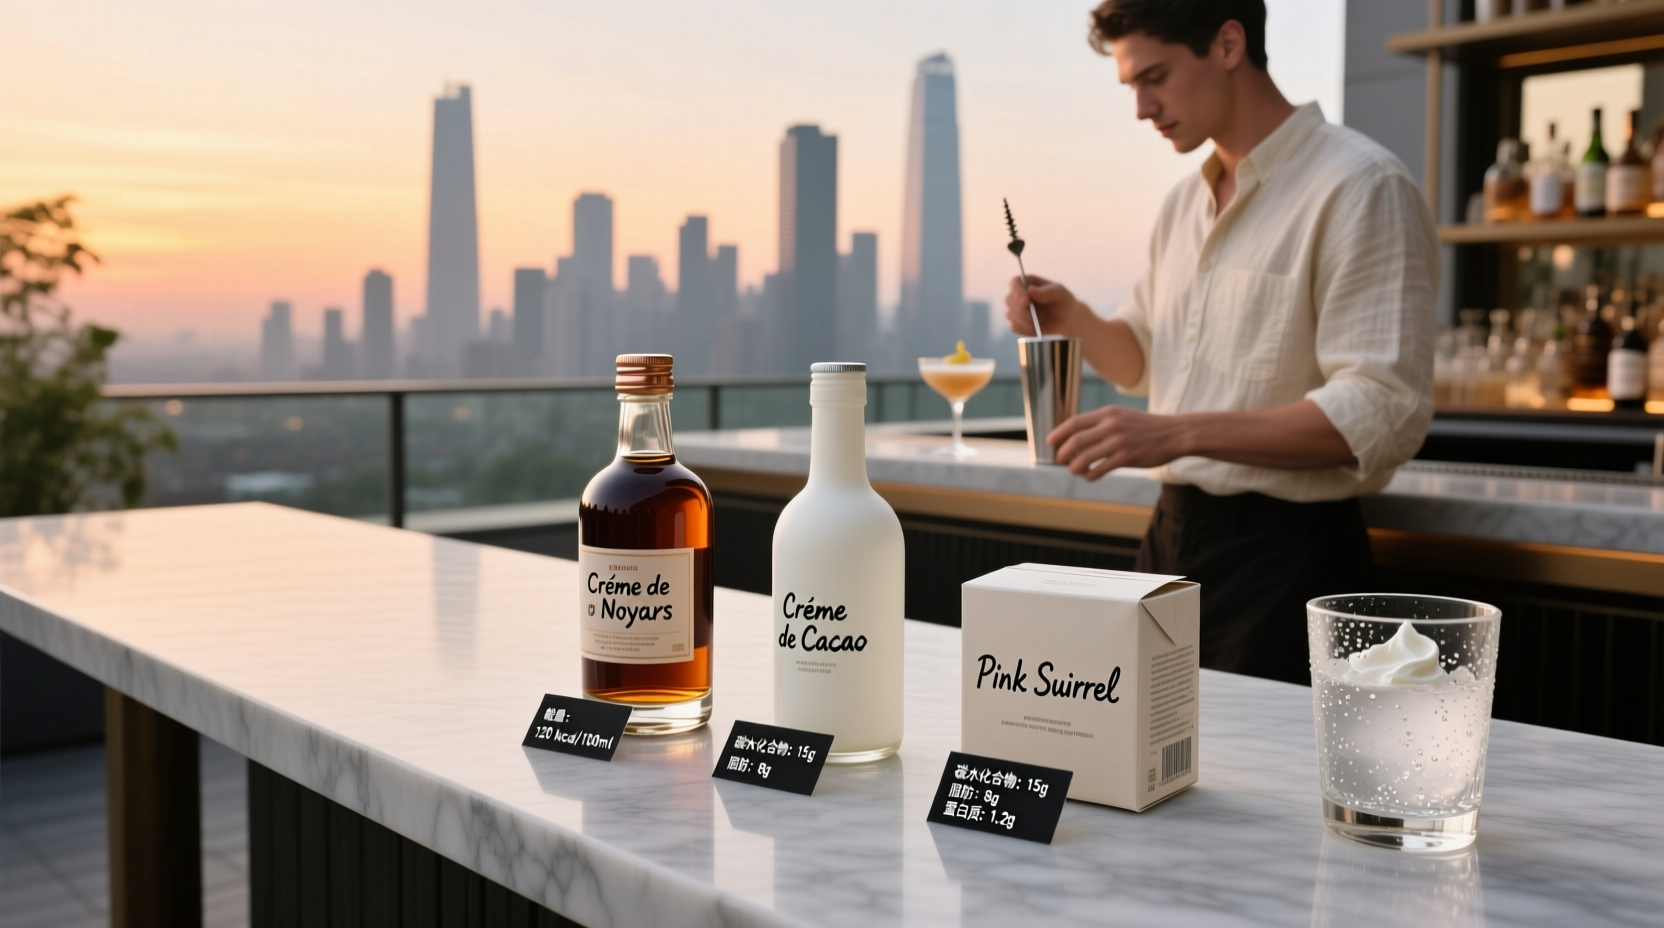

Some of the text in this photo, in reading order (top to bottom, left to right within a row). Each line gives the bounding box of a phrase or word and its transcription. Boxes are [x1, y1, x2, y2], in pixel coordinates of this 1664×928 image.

[587, 572, 670, 596] Créme de
[601, 597, 673, 629] Noyars
[783, 592, 848, 621] Créme
[778, 623, 868, 652] de Cacao
[976, 654, 1028, 693] Pink
[1033, 661, 1121, 704] Suirrel
[797, 745, 817, 763] 15g
[983, 789, 1000, 807] 8g
[1026, 778, 1049, 799] 15g
[989, 808, 1016, 830] 1.2g
